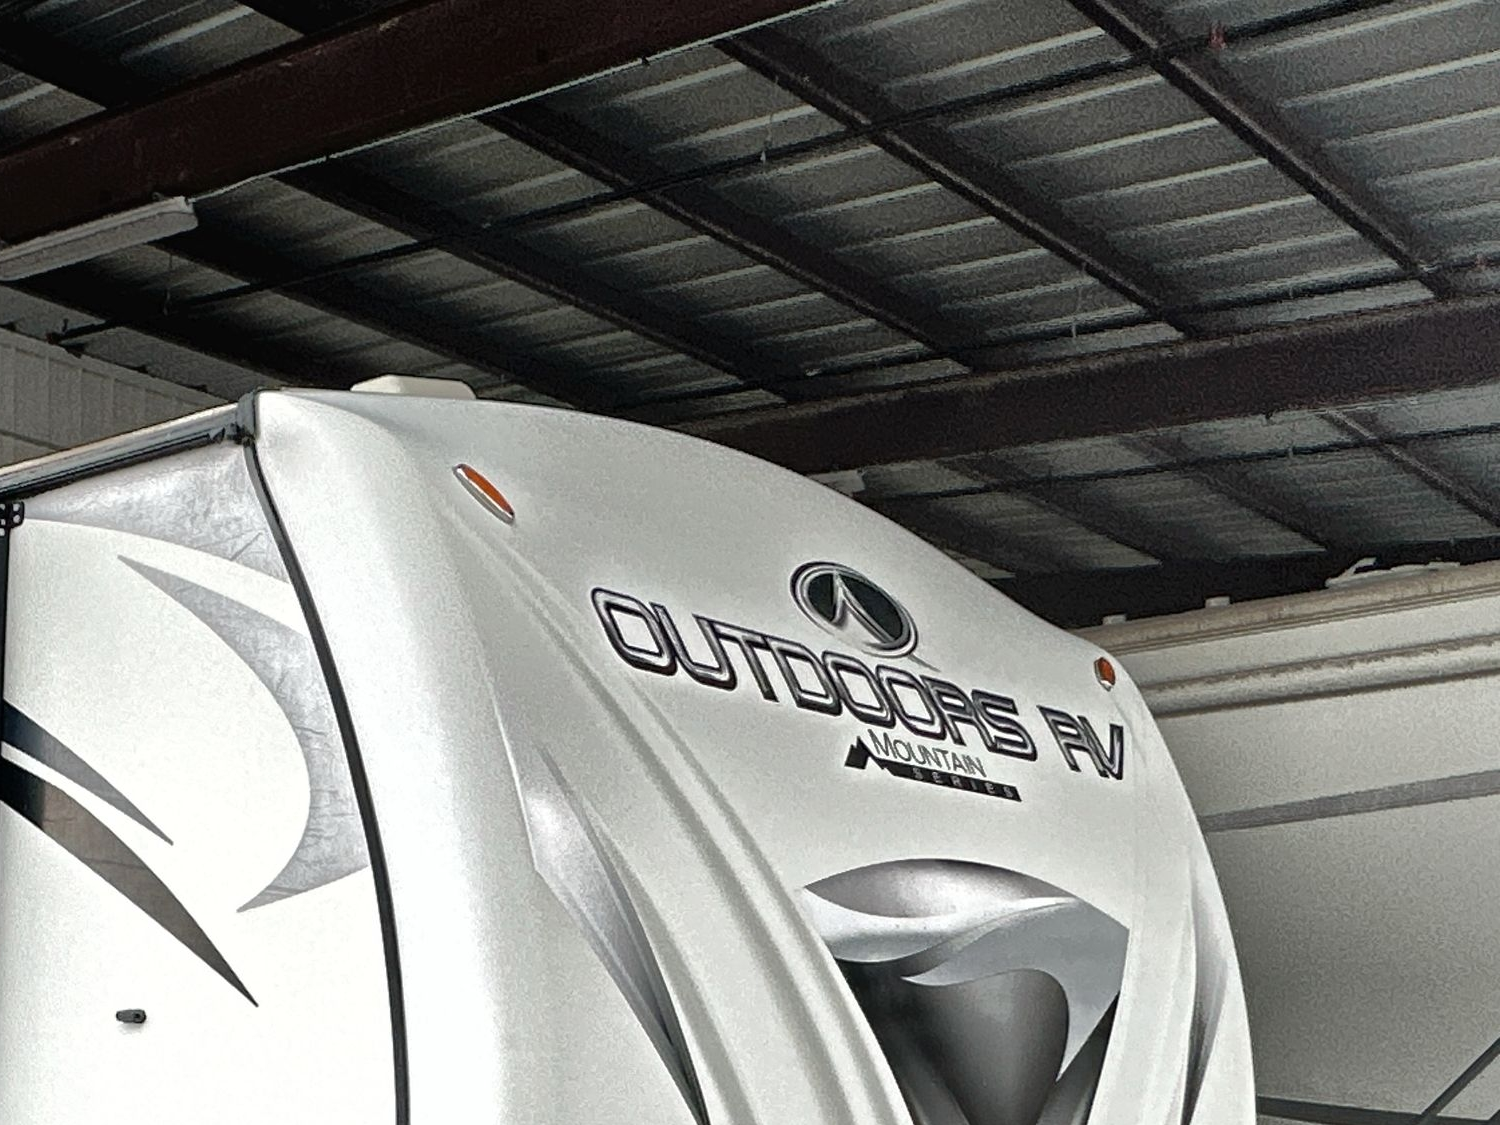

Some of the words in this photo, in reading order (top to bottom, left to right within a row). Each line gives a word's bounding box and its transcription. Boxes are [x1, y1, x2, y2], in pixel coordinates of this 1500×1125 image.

[591, 586, 1037, 762] OUTDOORS
[1036, 705, 1124, 780] RV
[868, 728, 987, 778] MOUNTAIN
[912, 767, 1014, 798] SERIES
